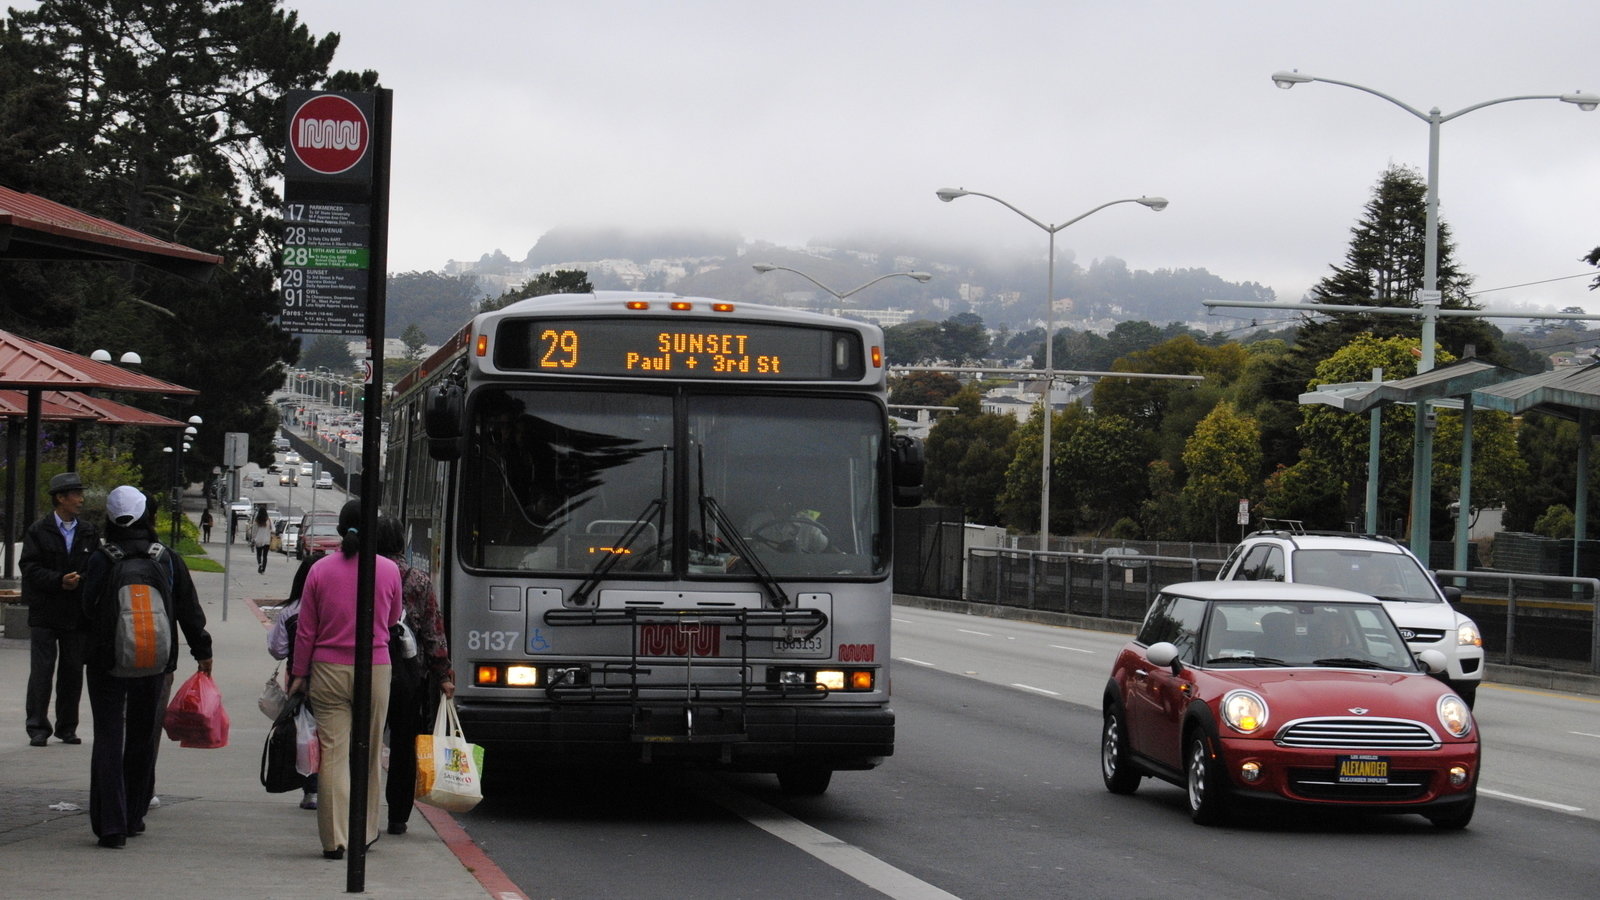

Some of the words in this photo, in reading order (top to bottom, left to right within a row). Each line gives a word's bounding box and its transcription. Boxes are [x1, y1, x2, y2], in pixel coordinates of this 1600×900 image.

[288, 204, 304, 221] 17
[286, 227, 305, 245] 28
[283, 269, 302, 287] 29
[285, 289, 302, 307] 91
[540, 330, 578, 368] 29
[658, 333, 748, 354] SUNSET
[626, 352, 670, 371] Paul
[713, 355, 749, 372] 3rd
[757, 356, 780, 374] St
[467, 630, 520, 651] 8137
[1340, 761, 1387, 776] ALEXANDER
